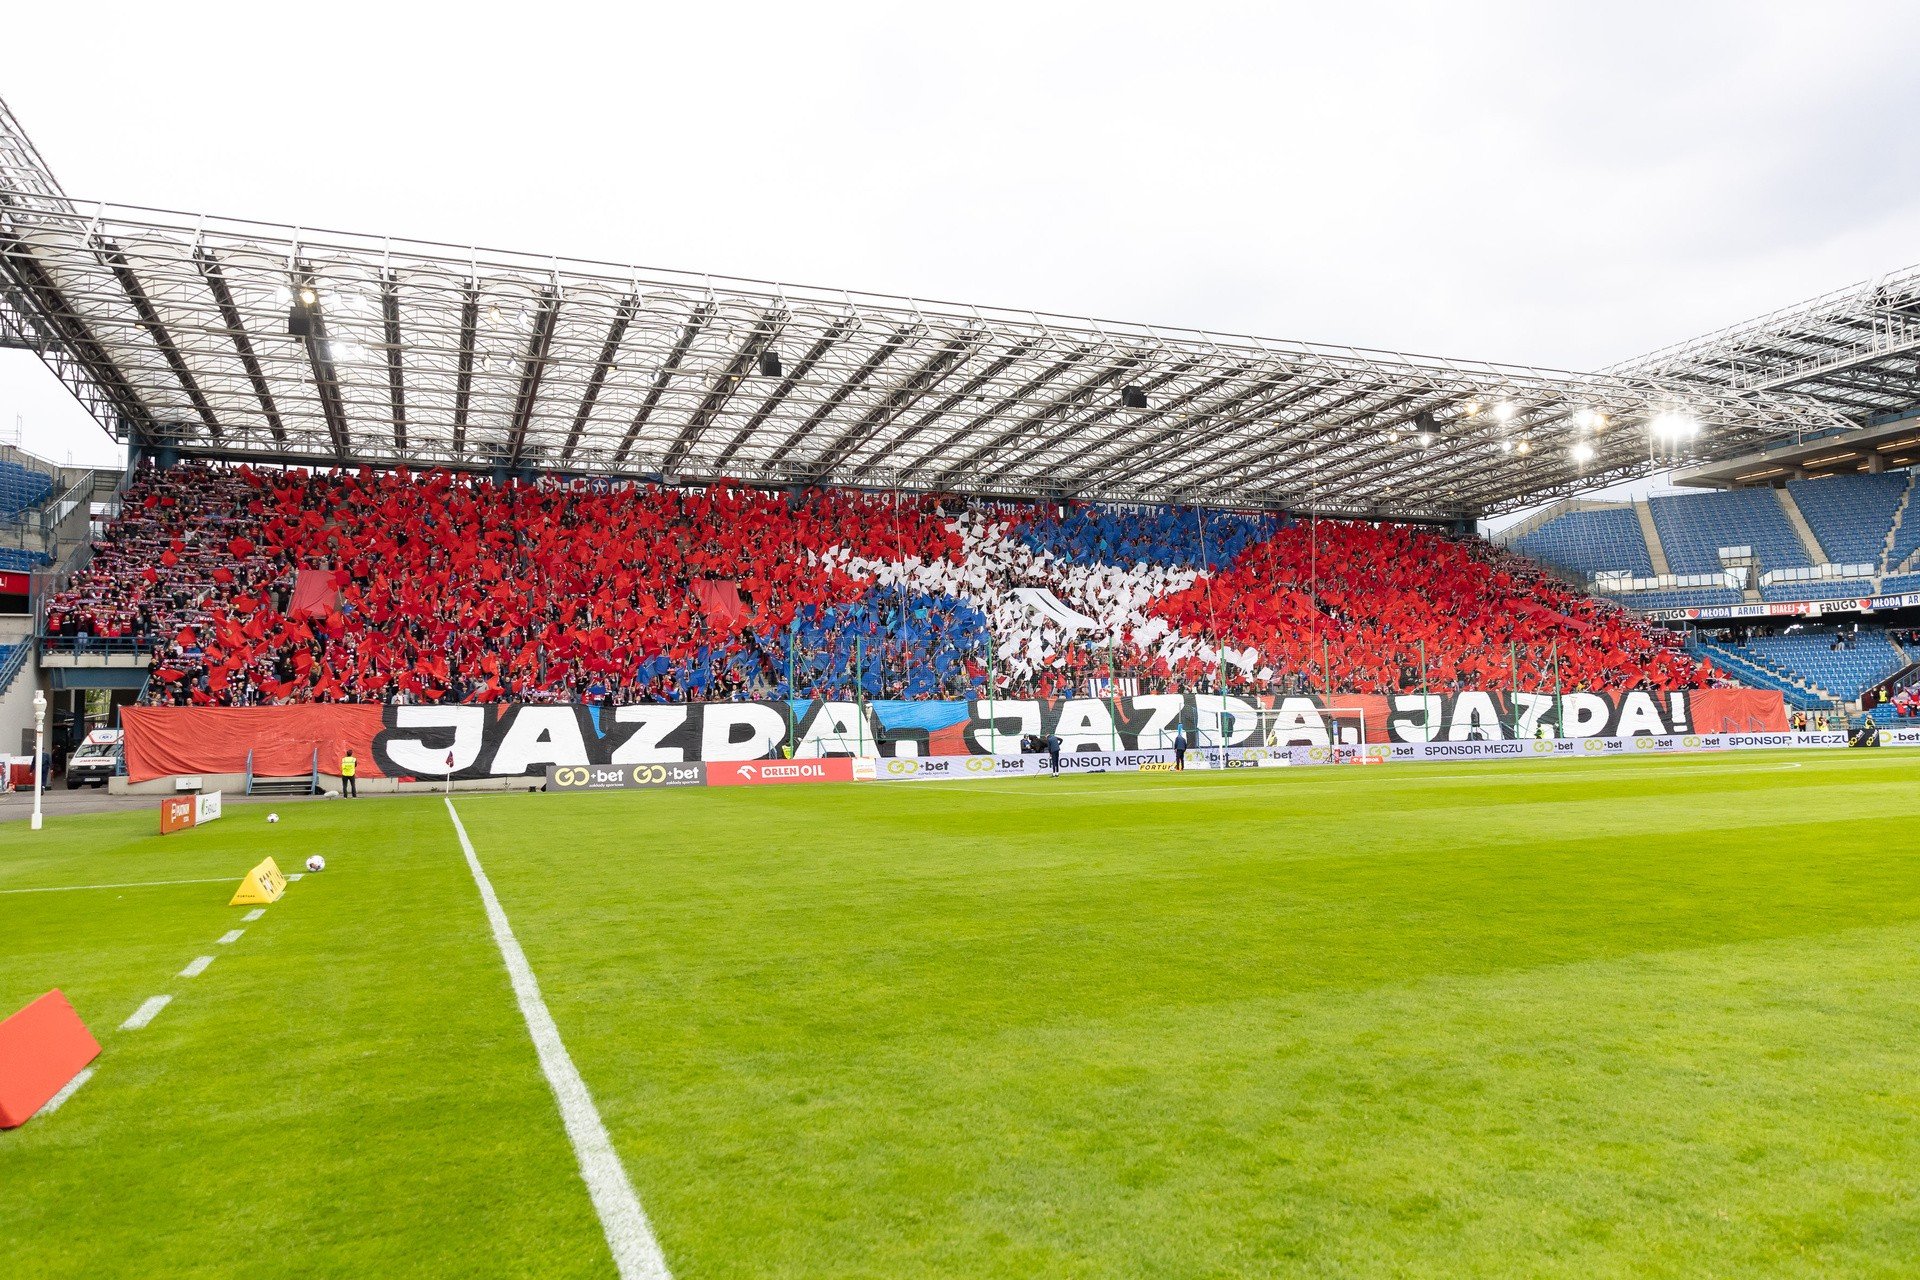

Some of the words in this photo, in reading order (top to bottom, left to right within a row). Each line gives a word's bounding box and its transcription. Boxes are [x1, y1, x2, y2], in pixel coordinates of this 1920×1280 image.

[1820, 600, 1857, 612] FRUGO
[1393, 691, 1688, 742] JAZDA!
[1424, 745, 1481, 755] SPONSOR
[1484, 744, 1523, 754] MECZU
[1115, 755, 1164, 766] MECZU
[764, 767, 797, 776] ORLEN
[801, 765, 825, 776] OIL
